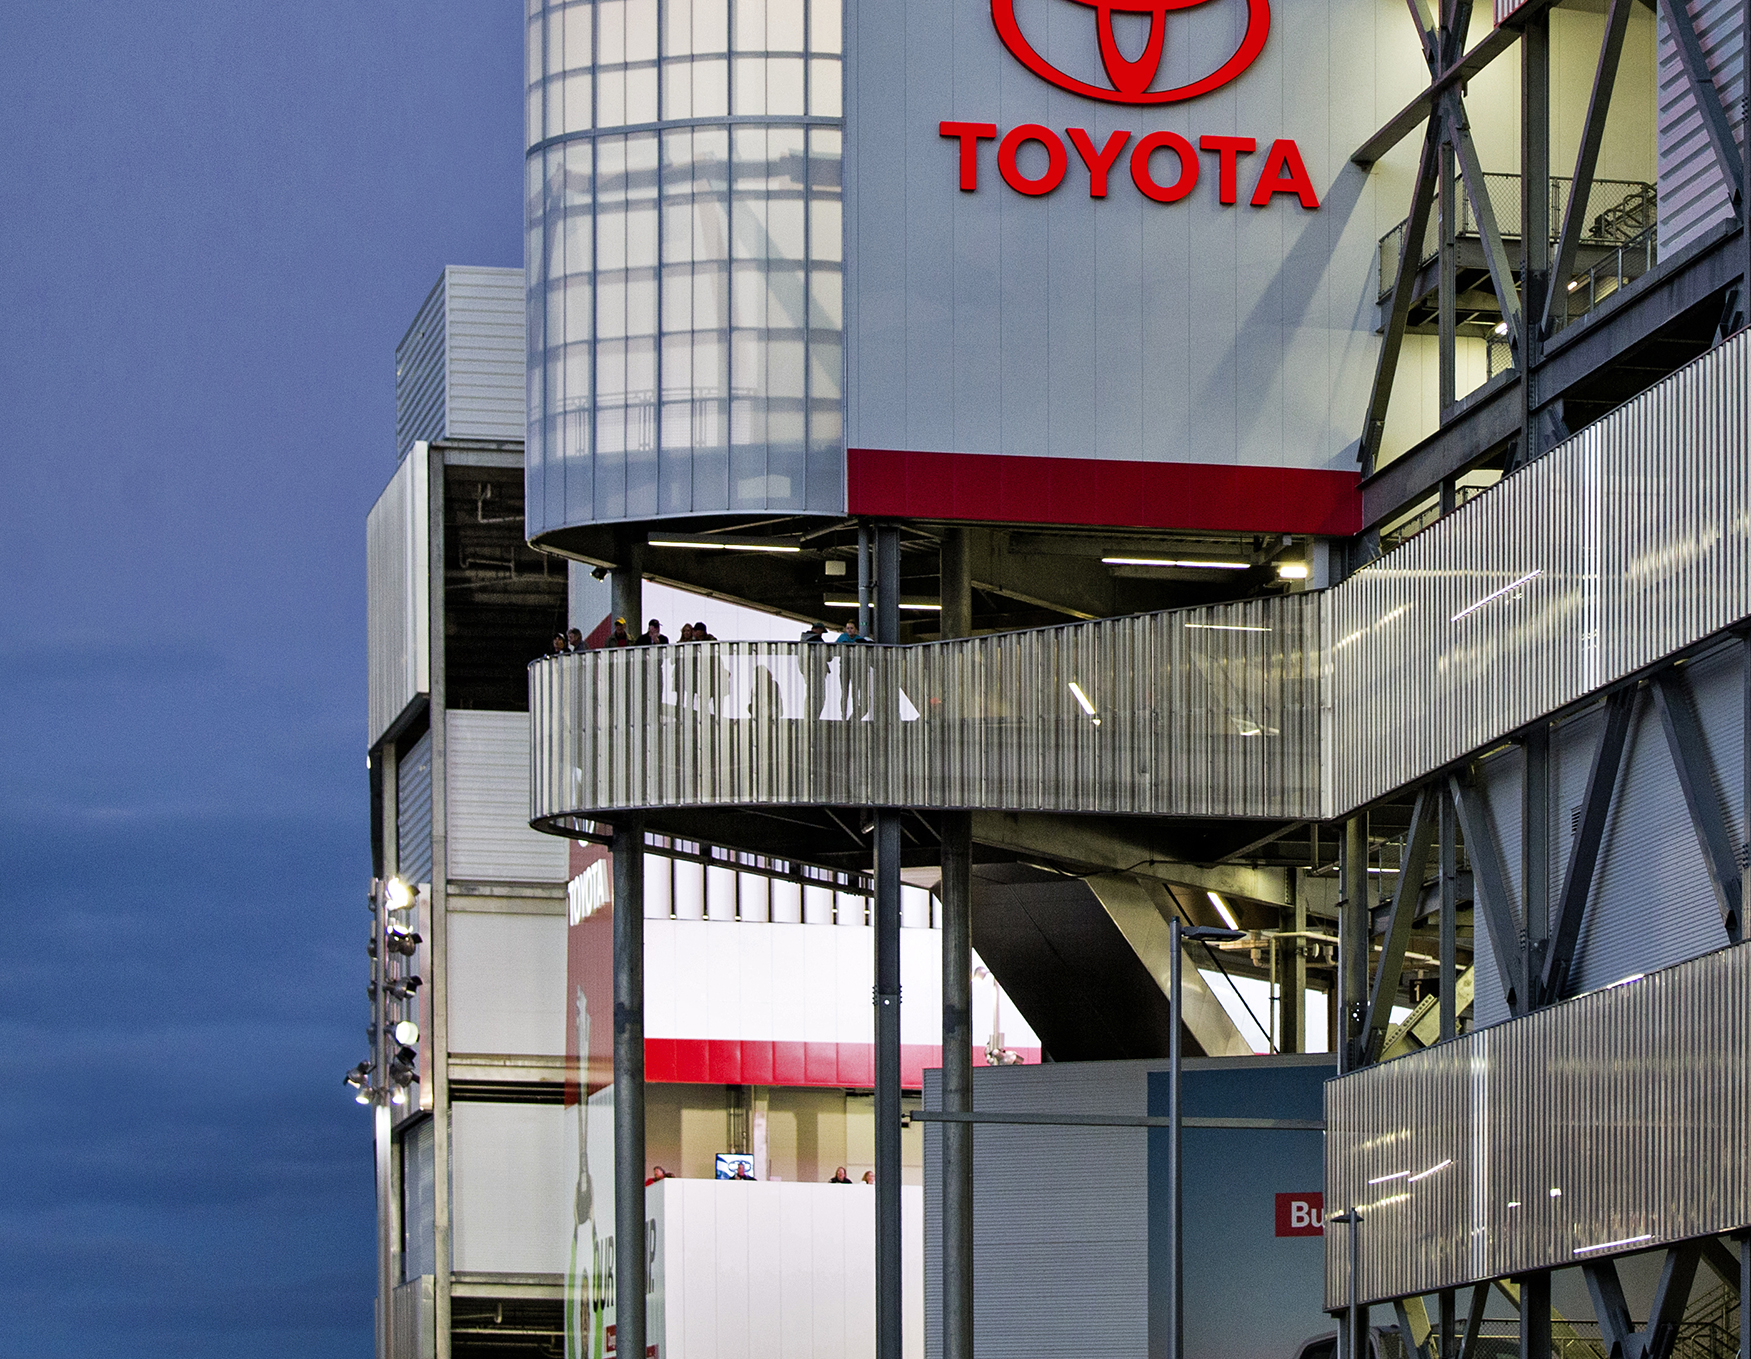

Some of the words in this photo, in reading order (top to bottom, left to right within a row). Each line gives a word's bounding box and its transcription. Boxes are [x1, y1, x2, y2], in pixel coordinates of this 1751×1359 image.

[939, 121, 1320, 208] TOYOTA
[567, 858, 610, 927] TOYOTA
[1414, 984, 1420, 1002] 1
[1291, 1201, 1324, 1228] Bu
